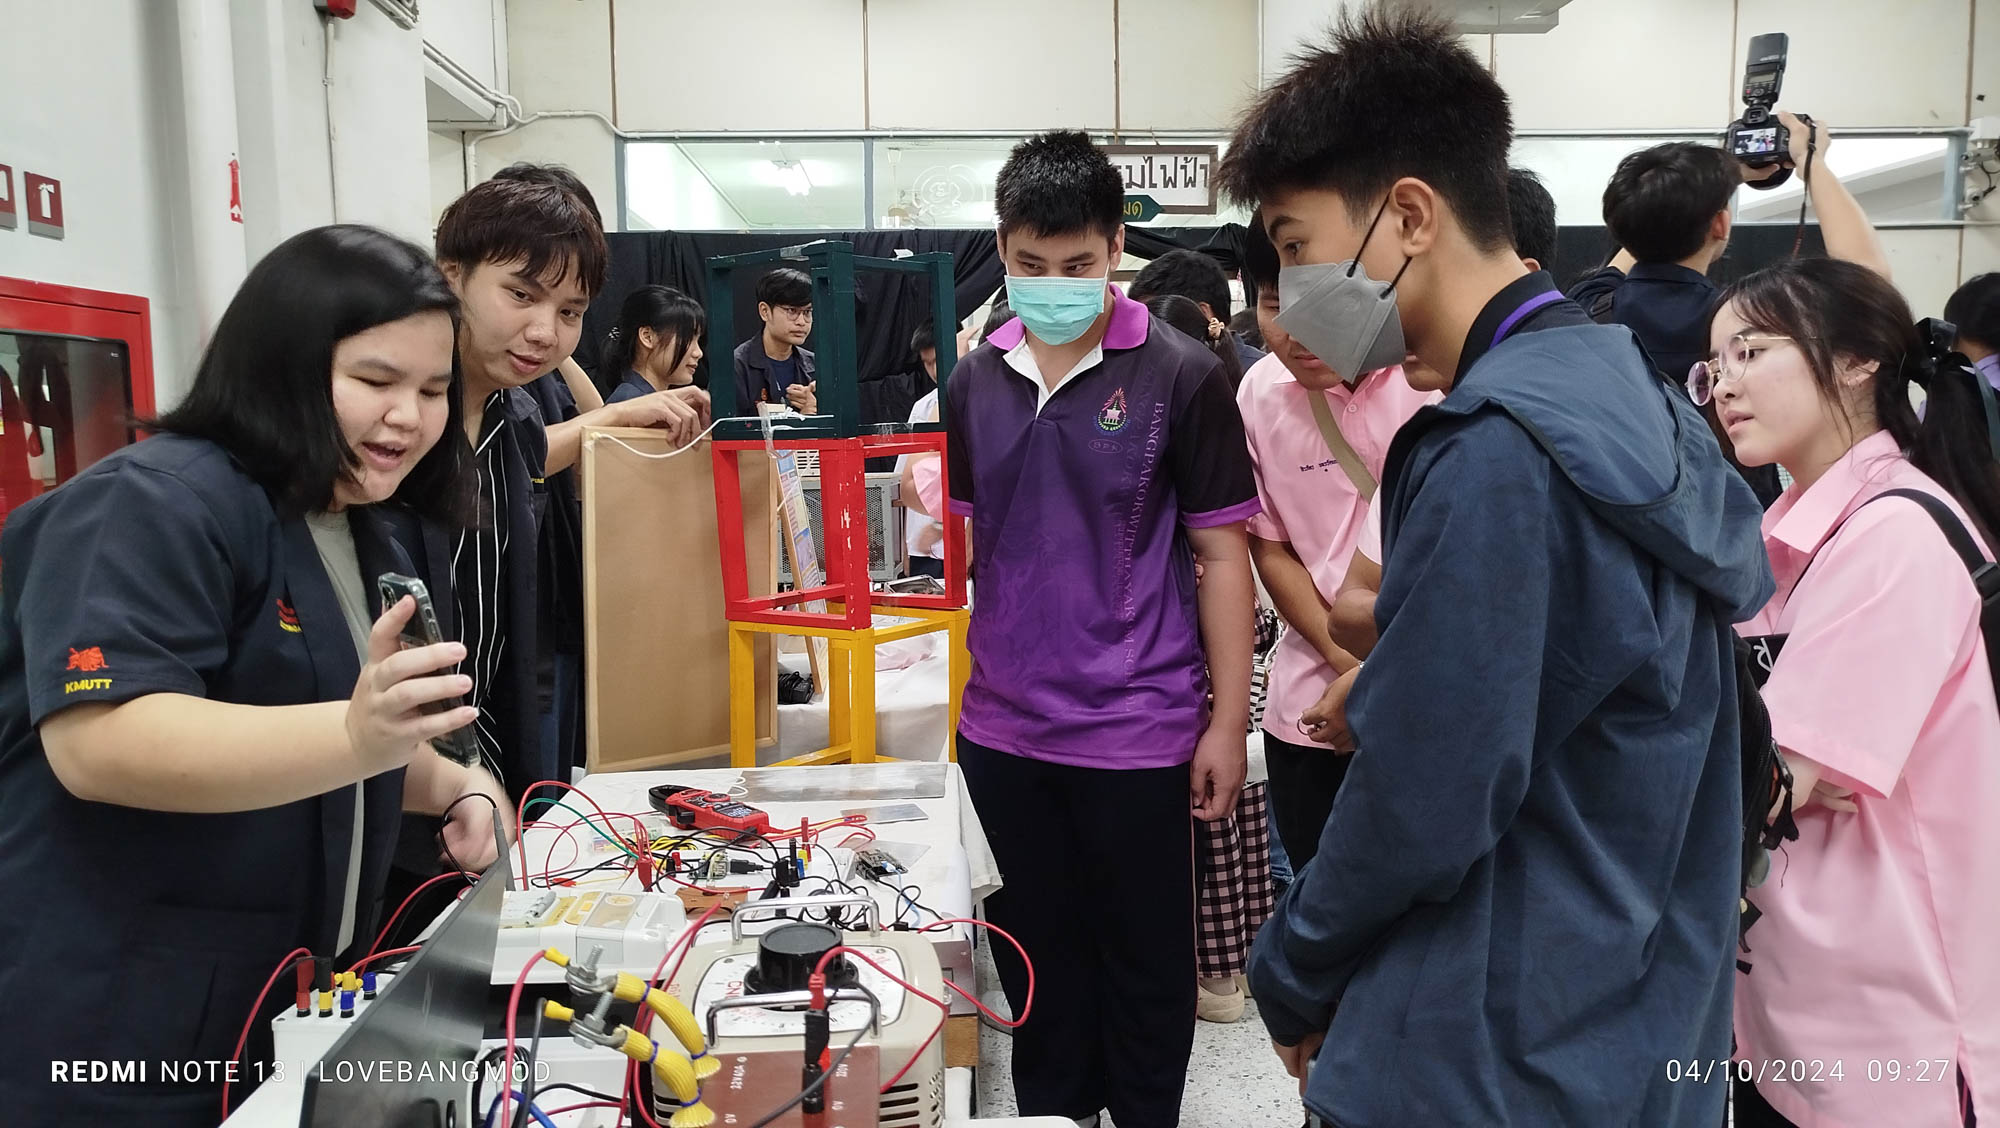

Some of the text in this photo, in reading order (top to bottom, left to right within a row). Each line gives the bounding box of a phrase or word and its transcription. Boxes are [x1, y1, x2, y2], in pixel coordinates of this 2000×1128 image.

[1115, 156, 1208, 189] มไฟฟ้า
[65, 678, 112, 694] KMUTT
